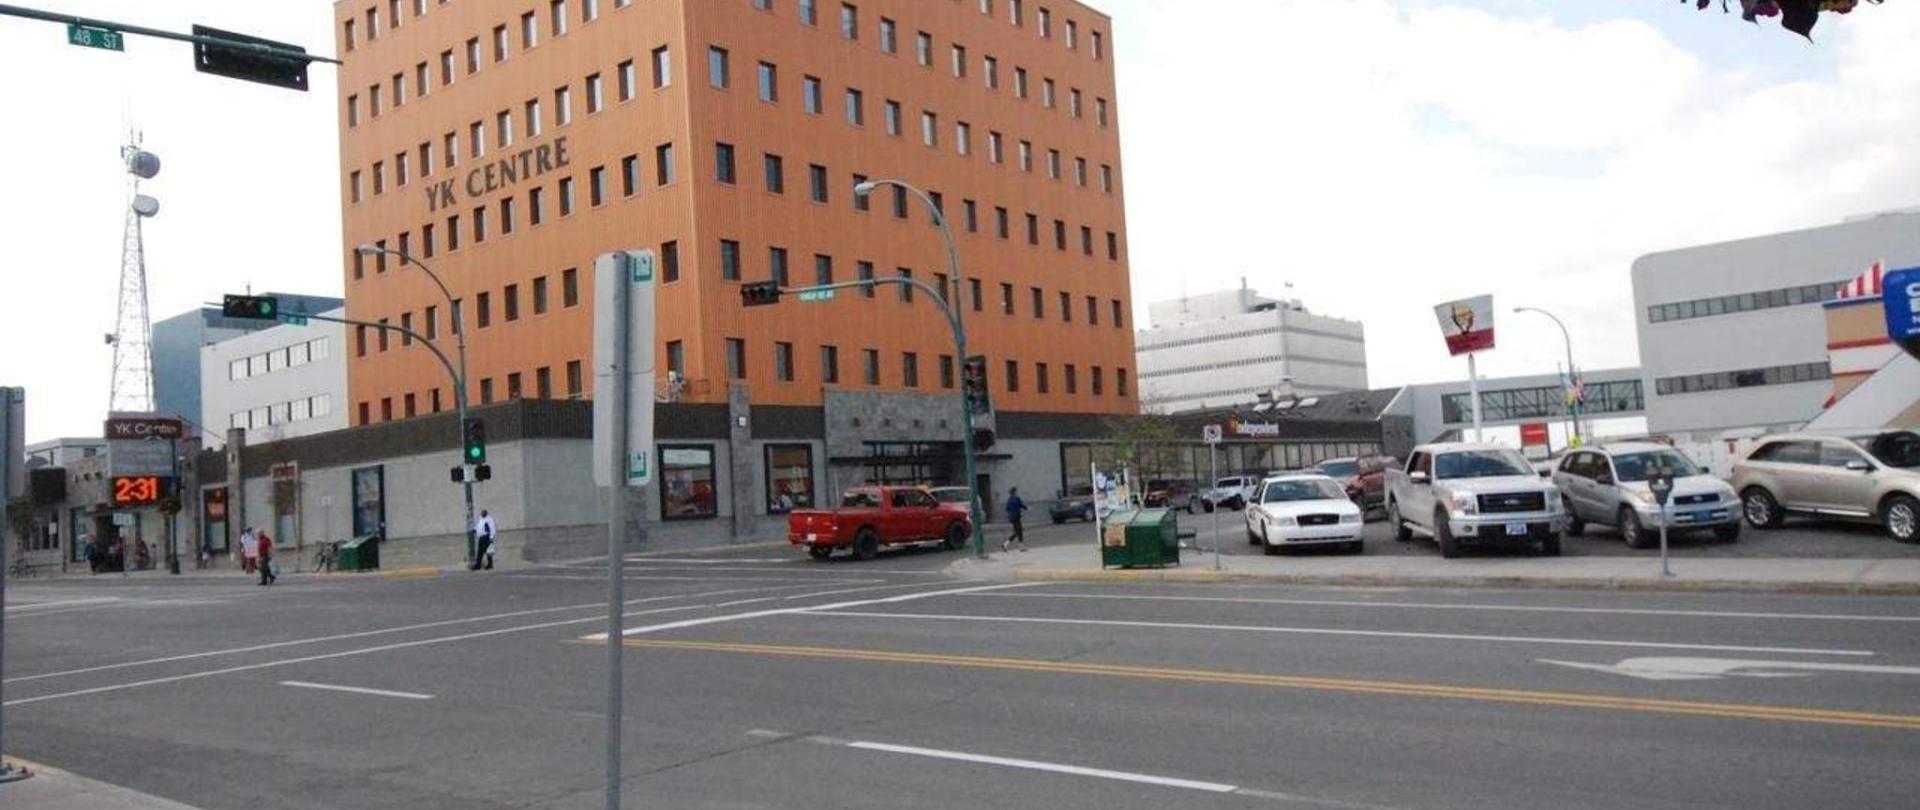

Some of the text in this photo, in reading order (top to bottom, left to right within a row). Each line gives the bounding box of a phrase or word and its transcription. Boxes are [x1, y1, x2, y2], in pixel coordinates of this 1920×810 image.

[74, 29, 117, 49] 48 ST
[425, 136, 570, 212] YK CENTRE
[113, 423, 132, 434] YK
[116, 478, 157, 500] 2:31
